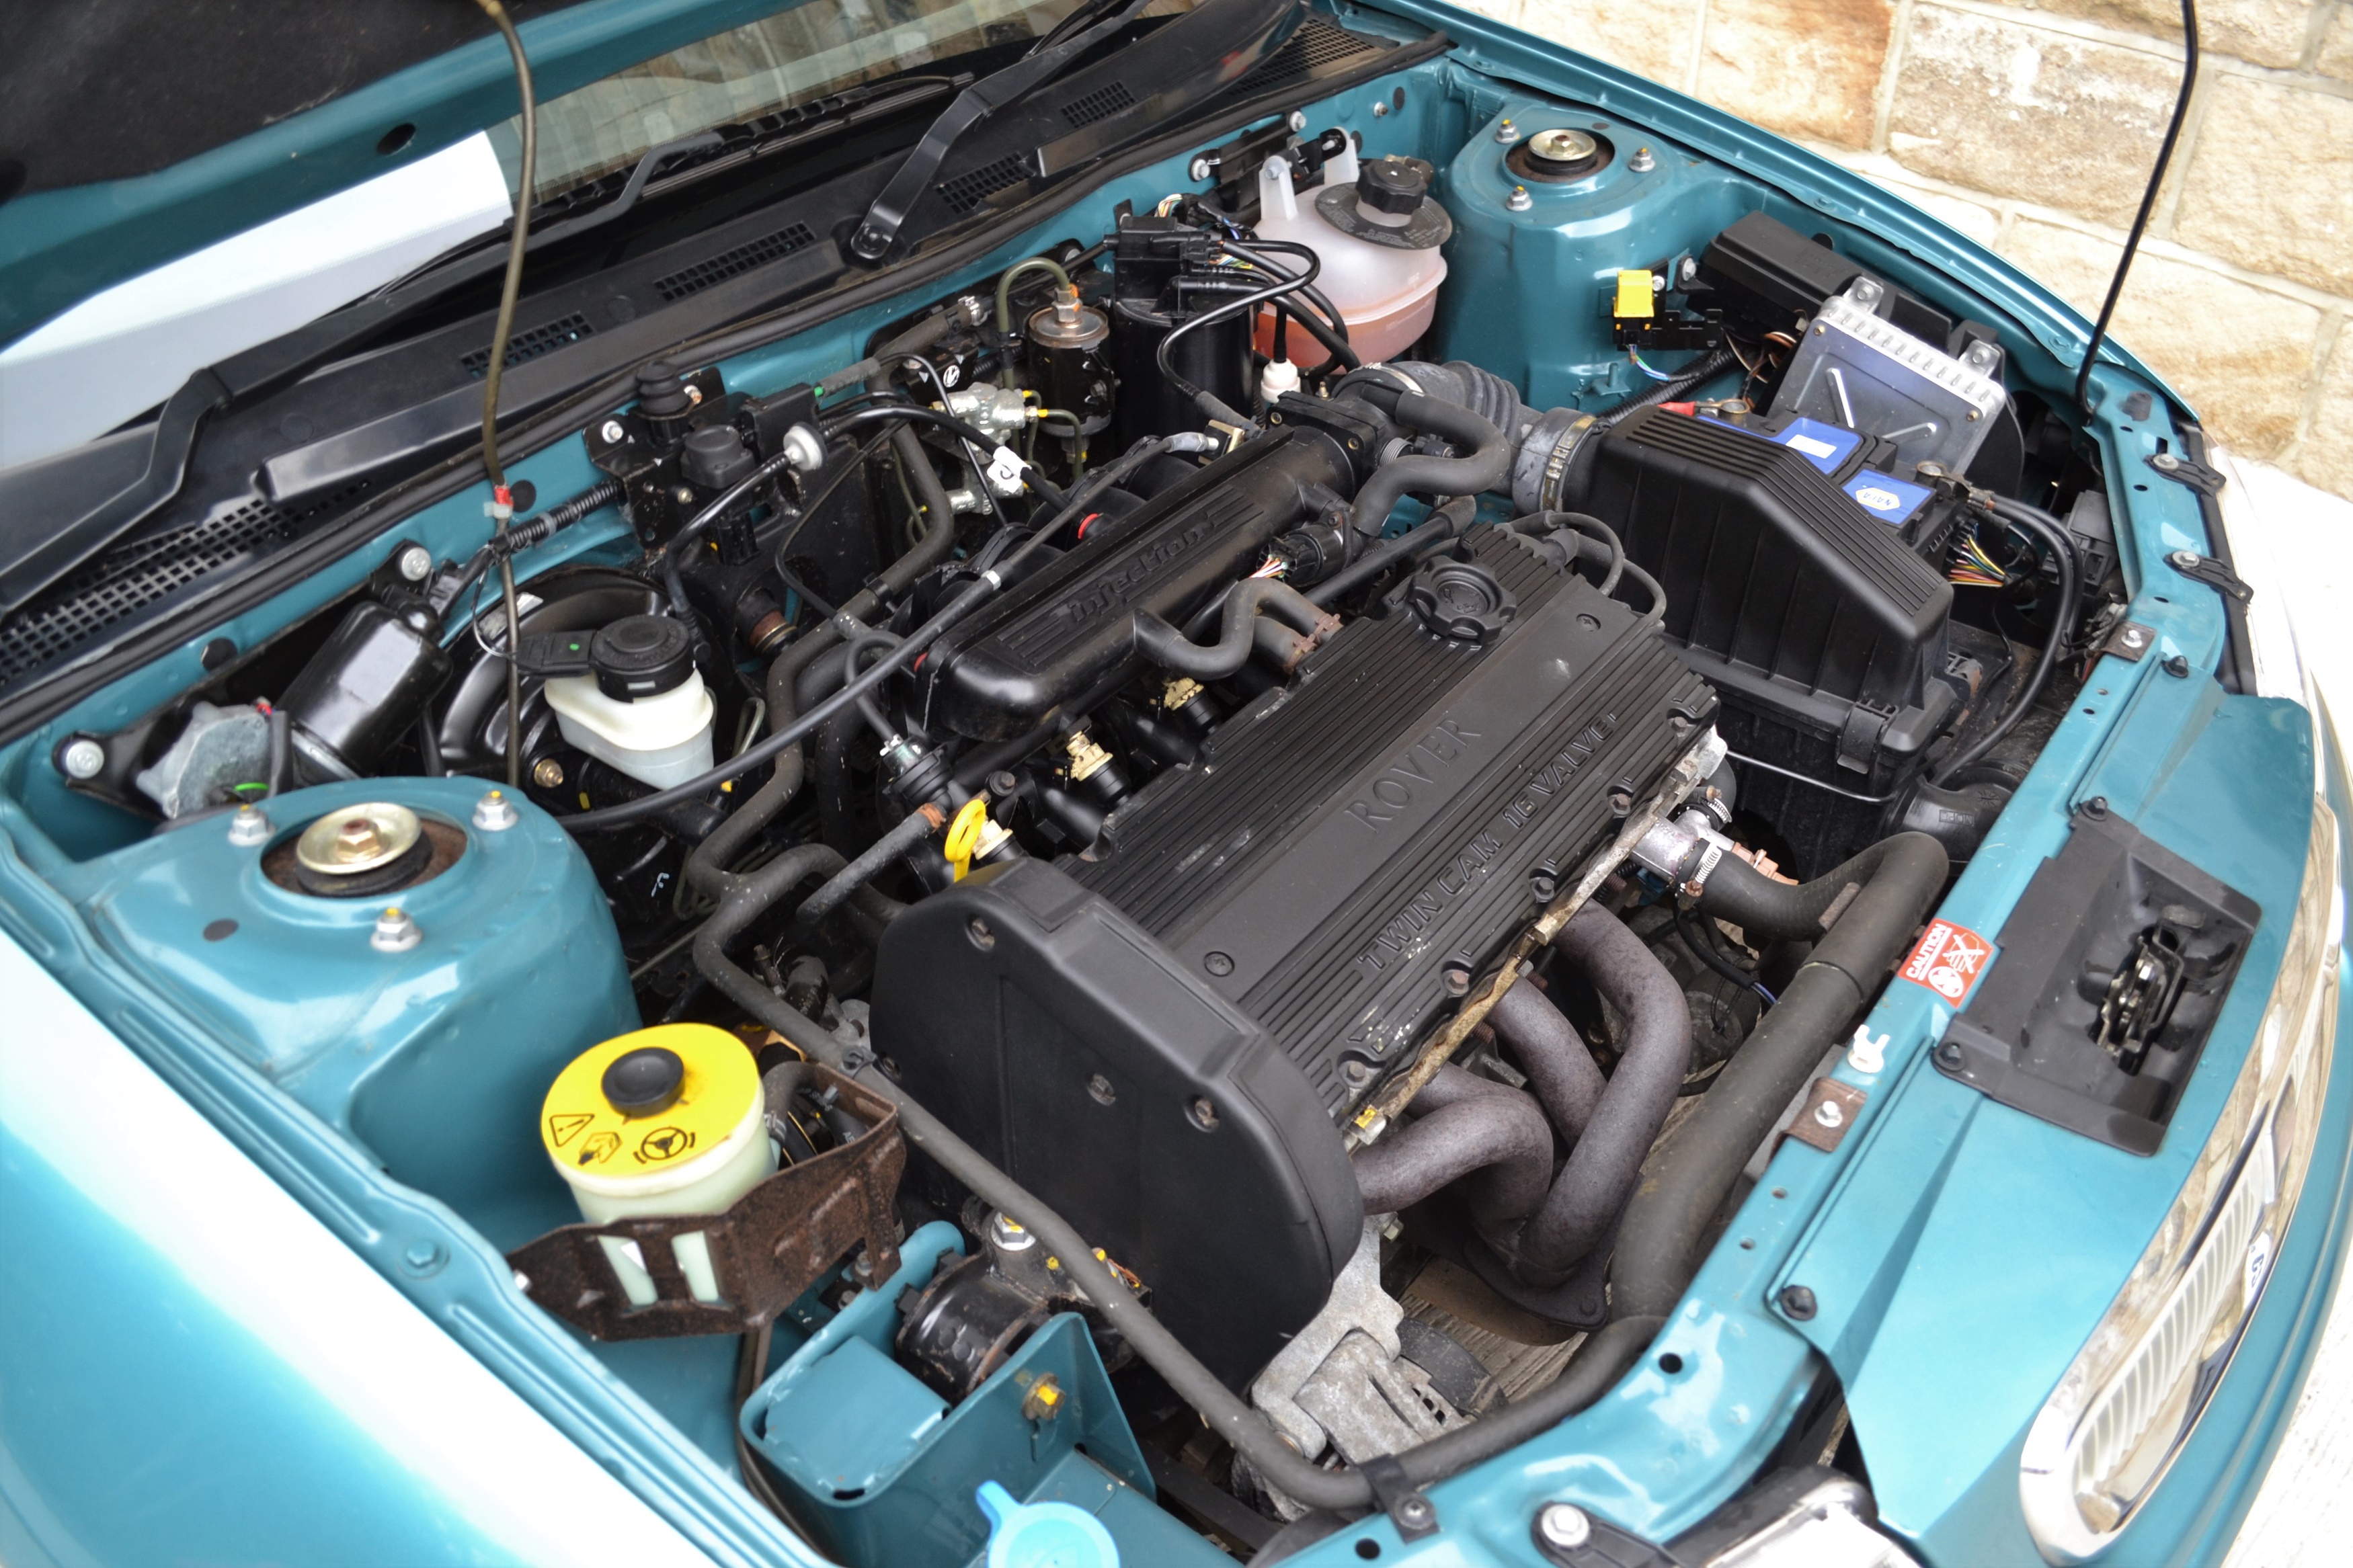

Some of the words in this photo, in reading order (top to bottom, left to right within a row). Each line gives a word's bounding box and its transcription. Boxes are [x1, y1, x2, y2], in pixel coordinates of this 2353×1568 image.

[1068, 526, 1205, 622] injection
[1345, 719, 1482, 831] ROVER
[1357, 889, 1443, 971] TWIN
[1438, 832, 1504, 899] CAM
[1502, 796, 1538, 829] 16
[1530, 718, 1613, 796] VALVE
[1906, 923, 1947, 979] CAUTION
